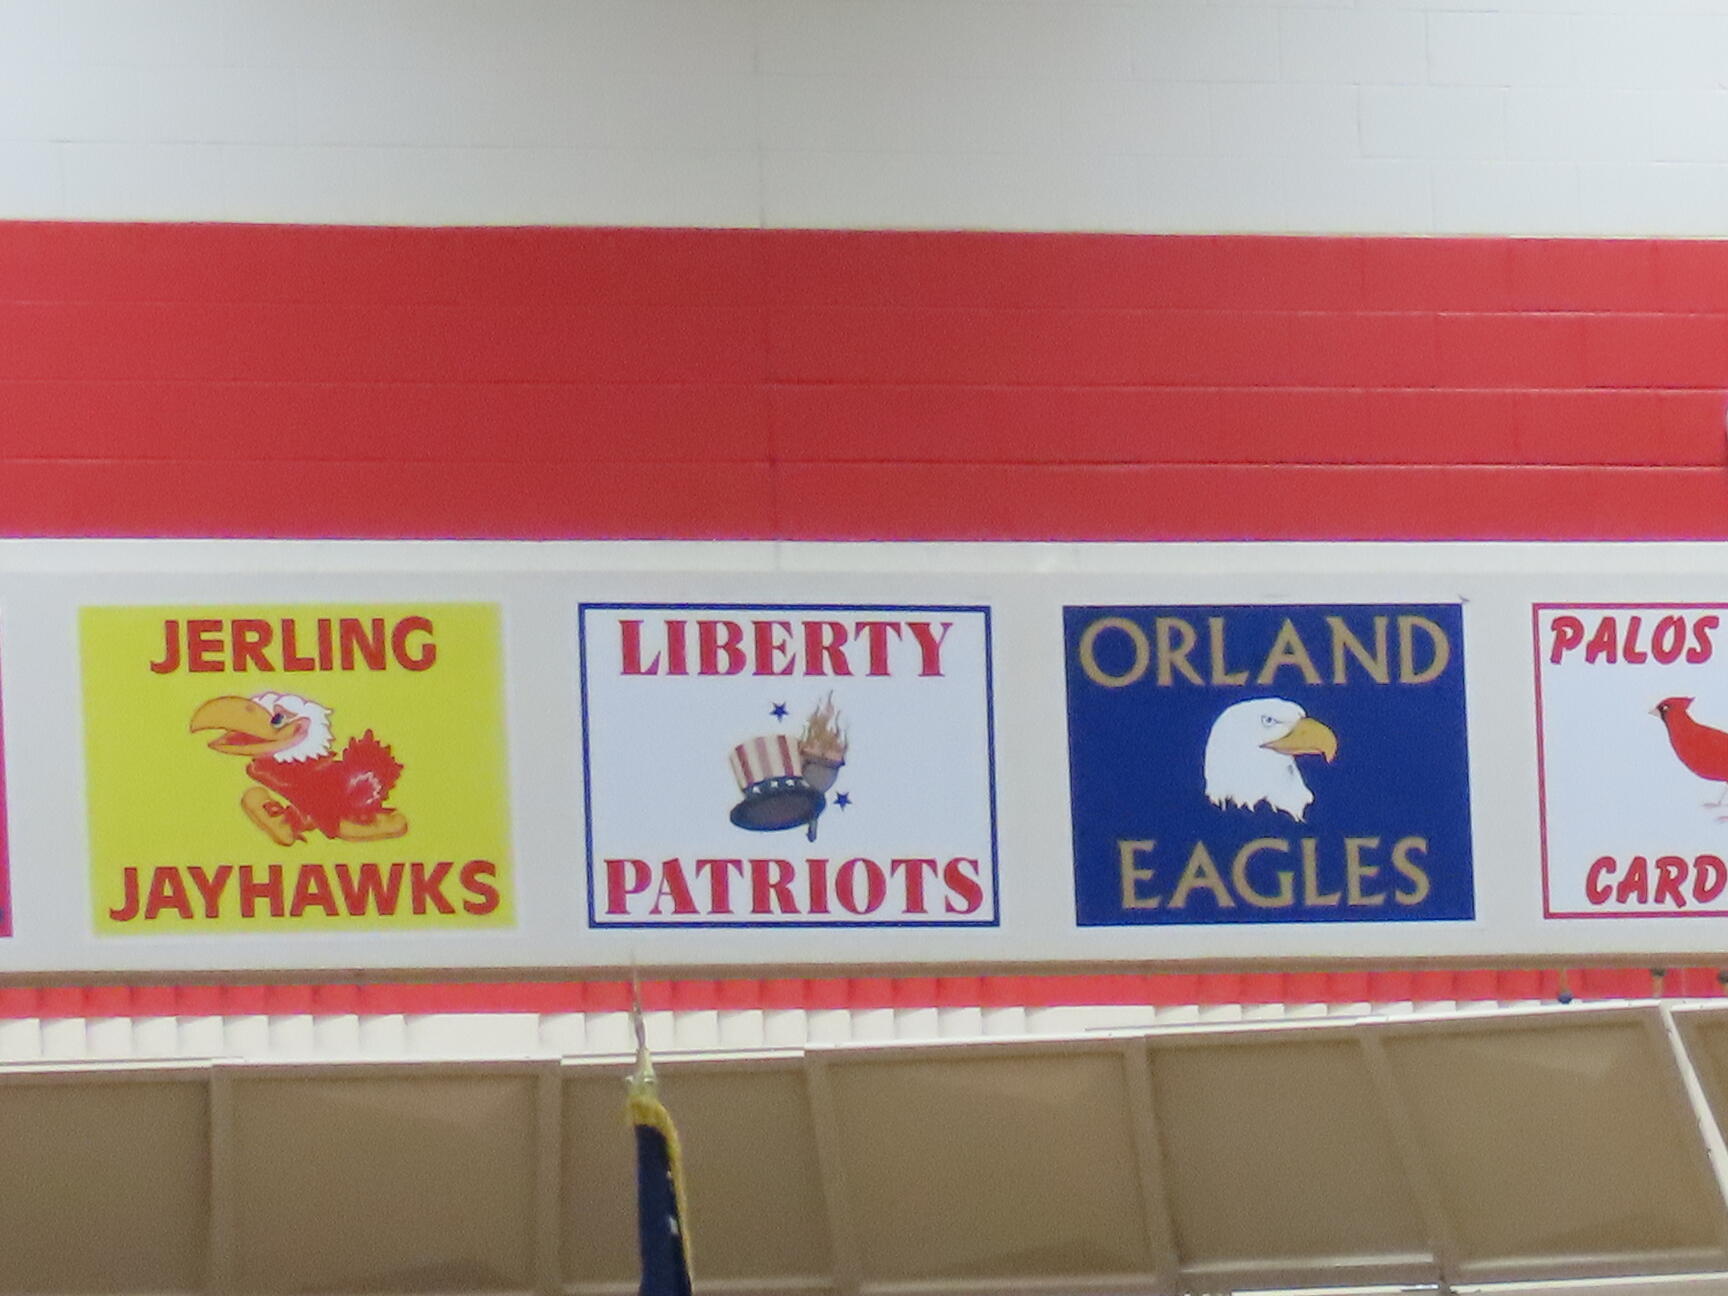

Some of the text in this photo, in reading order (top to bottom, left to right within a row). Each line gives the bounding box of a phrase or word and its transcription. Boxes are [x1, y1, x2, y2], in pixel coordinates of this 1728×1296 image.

[149, 615, 439, 675] JERLING
[617, 618, 955, 679] LIBERTY
[1078, 615, 1451, 688] ORLAND
[1549, 614, 1719, 666] PALOS
[108, 860, 502, 923] JAYHAWKS
[602, 855, 984, 917] PATRIOTS
[1117, 836, 1431, 910] EAGLES
